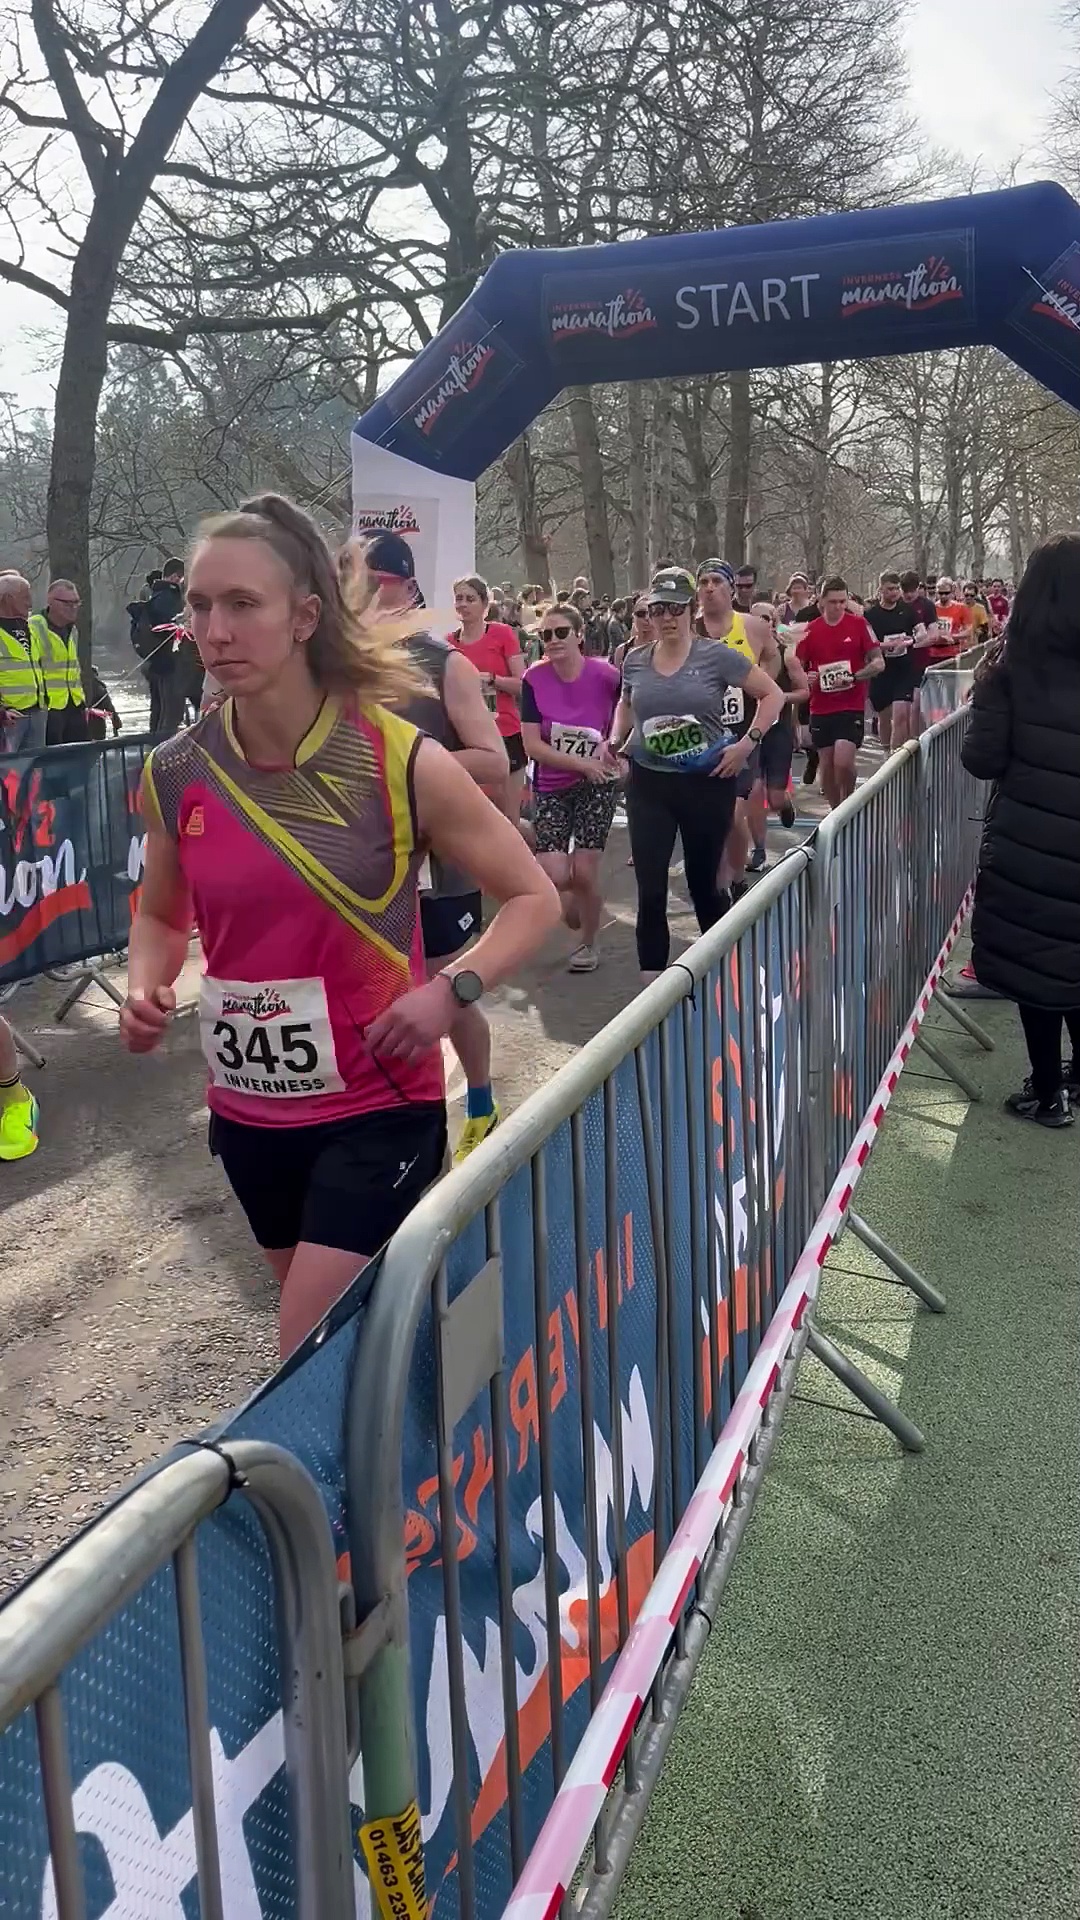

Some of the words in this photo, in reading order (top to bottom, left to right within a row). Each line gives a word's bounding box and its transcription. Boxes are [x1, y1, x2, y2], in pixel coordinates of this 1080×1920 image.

[675, 273, 820, 329] START
[553, 738, 599, 757] 1747
[649, 723, 703, 756] 3246
[213, 1020, 319, 1075] 345
[224, 1073, 326, 1093] INVERNESS
[369, 1829, 399, 1888] 01463
